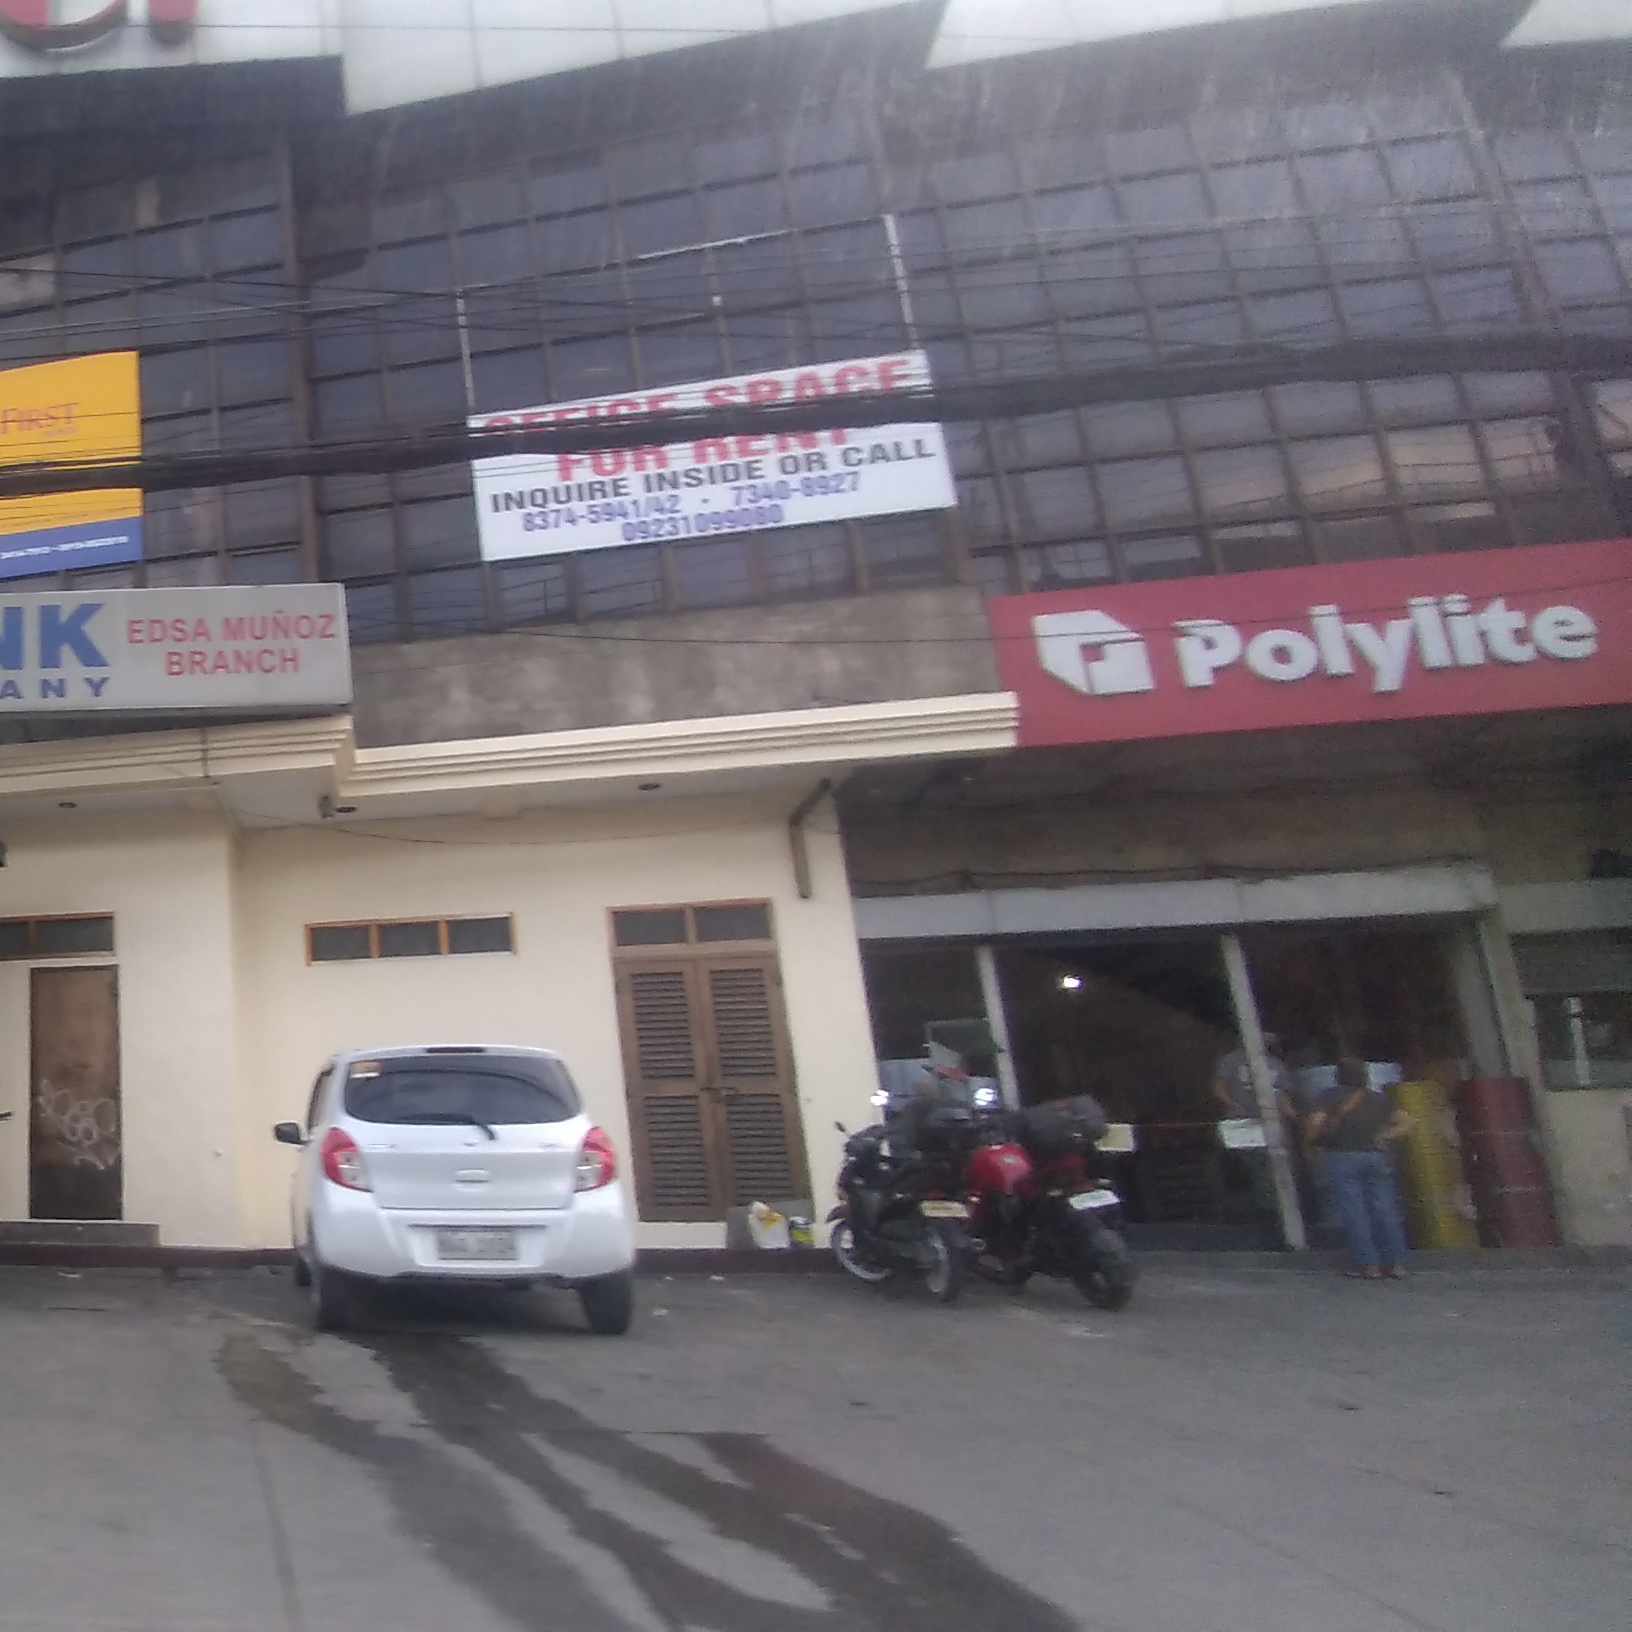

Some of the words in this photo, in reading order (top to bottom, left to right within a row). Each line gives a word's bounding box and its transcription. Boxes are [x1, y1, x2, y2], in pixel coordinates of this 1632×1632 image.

[704, 358, 908, 408] SPACE
[490, 477, 631, 514] INQUIRE
[643, 459, 765, 495] INSIDE
[779, 453, 829, 477] OR
[841, 437, 937, 469] CALL
[556, 446, 668, 482] FOR
[127, 617, 213, 645] EDSA
[223, 609, 338, 642] MUÑOZ
[1173, 592, 1599, 695] Polylite
[164, 649, 302, 678] BRANCH
